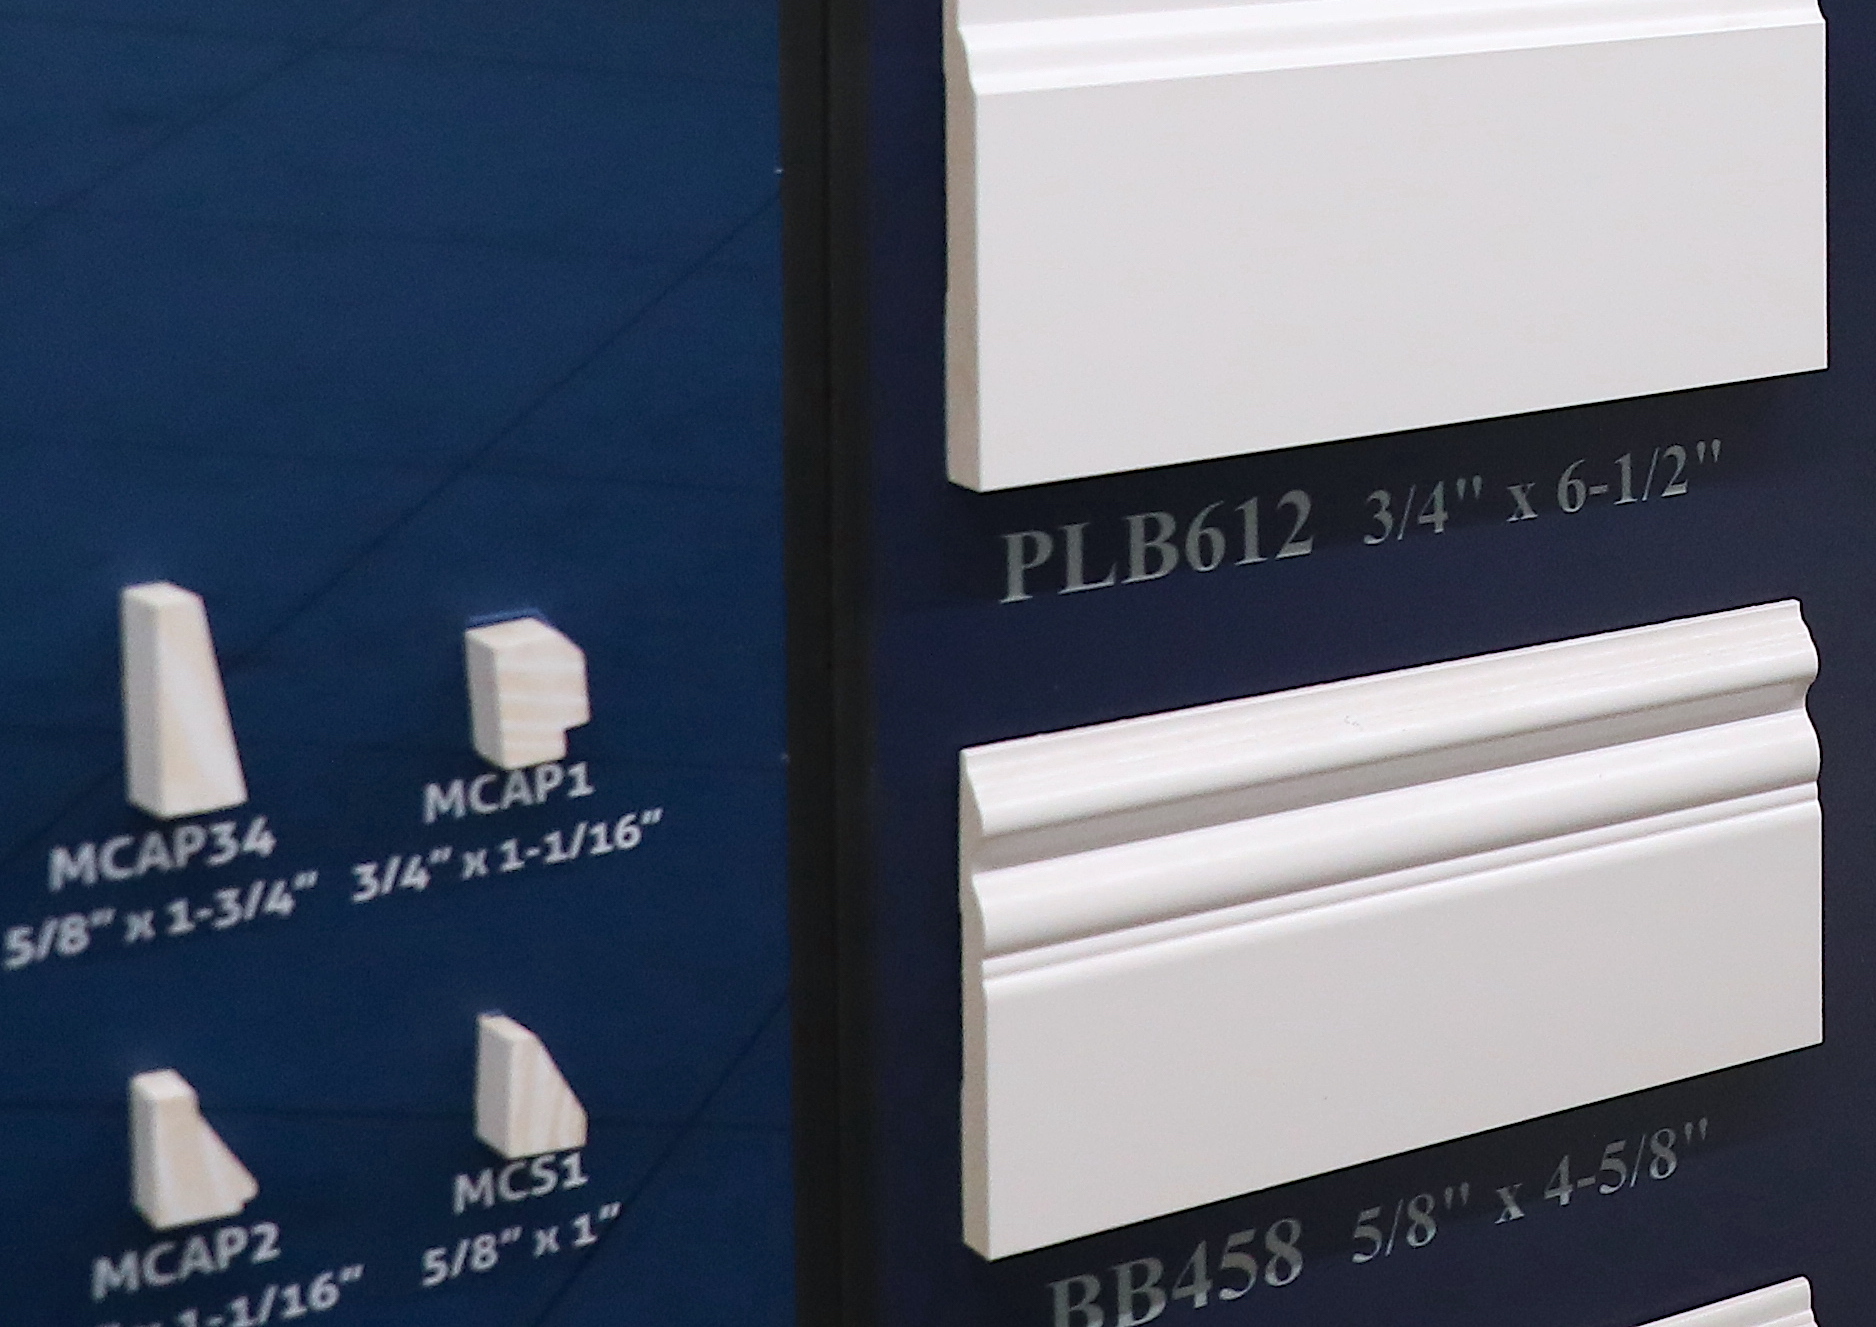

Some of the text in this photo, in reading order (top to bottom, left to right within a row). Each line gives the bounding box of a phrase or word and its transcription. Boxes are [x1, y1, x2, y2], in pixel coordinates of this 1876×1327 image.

[1000, 439, 1721, 603] PLB612 3/4" x 6-1/2"
[421, 761, 594, 824] MCAP1
[48, 816, 276, 891] MCAP34
[350, 807, 664, 902] 3/4" x 1-1/16"
[3, 870, 319, 971] 5/8" x 1-3/4"
[452, 1151, 589, 1214] MCS1
[1047, 1118, 1708, 1327] BB458 5/8" x 4-5/8"
[91, 1221, 280, 1301] MCAP2
[421, 1201, 621, 1287] 5/8" x 1"
